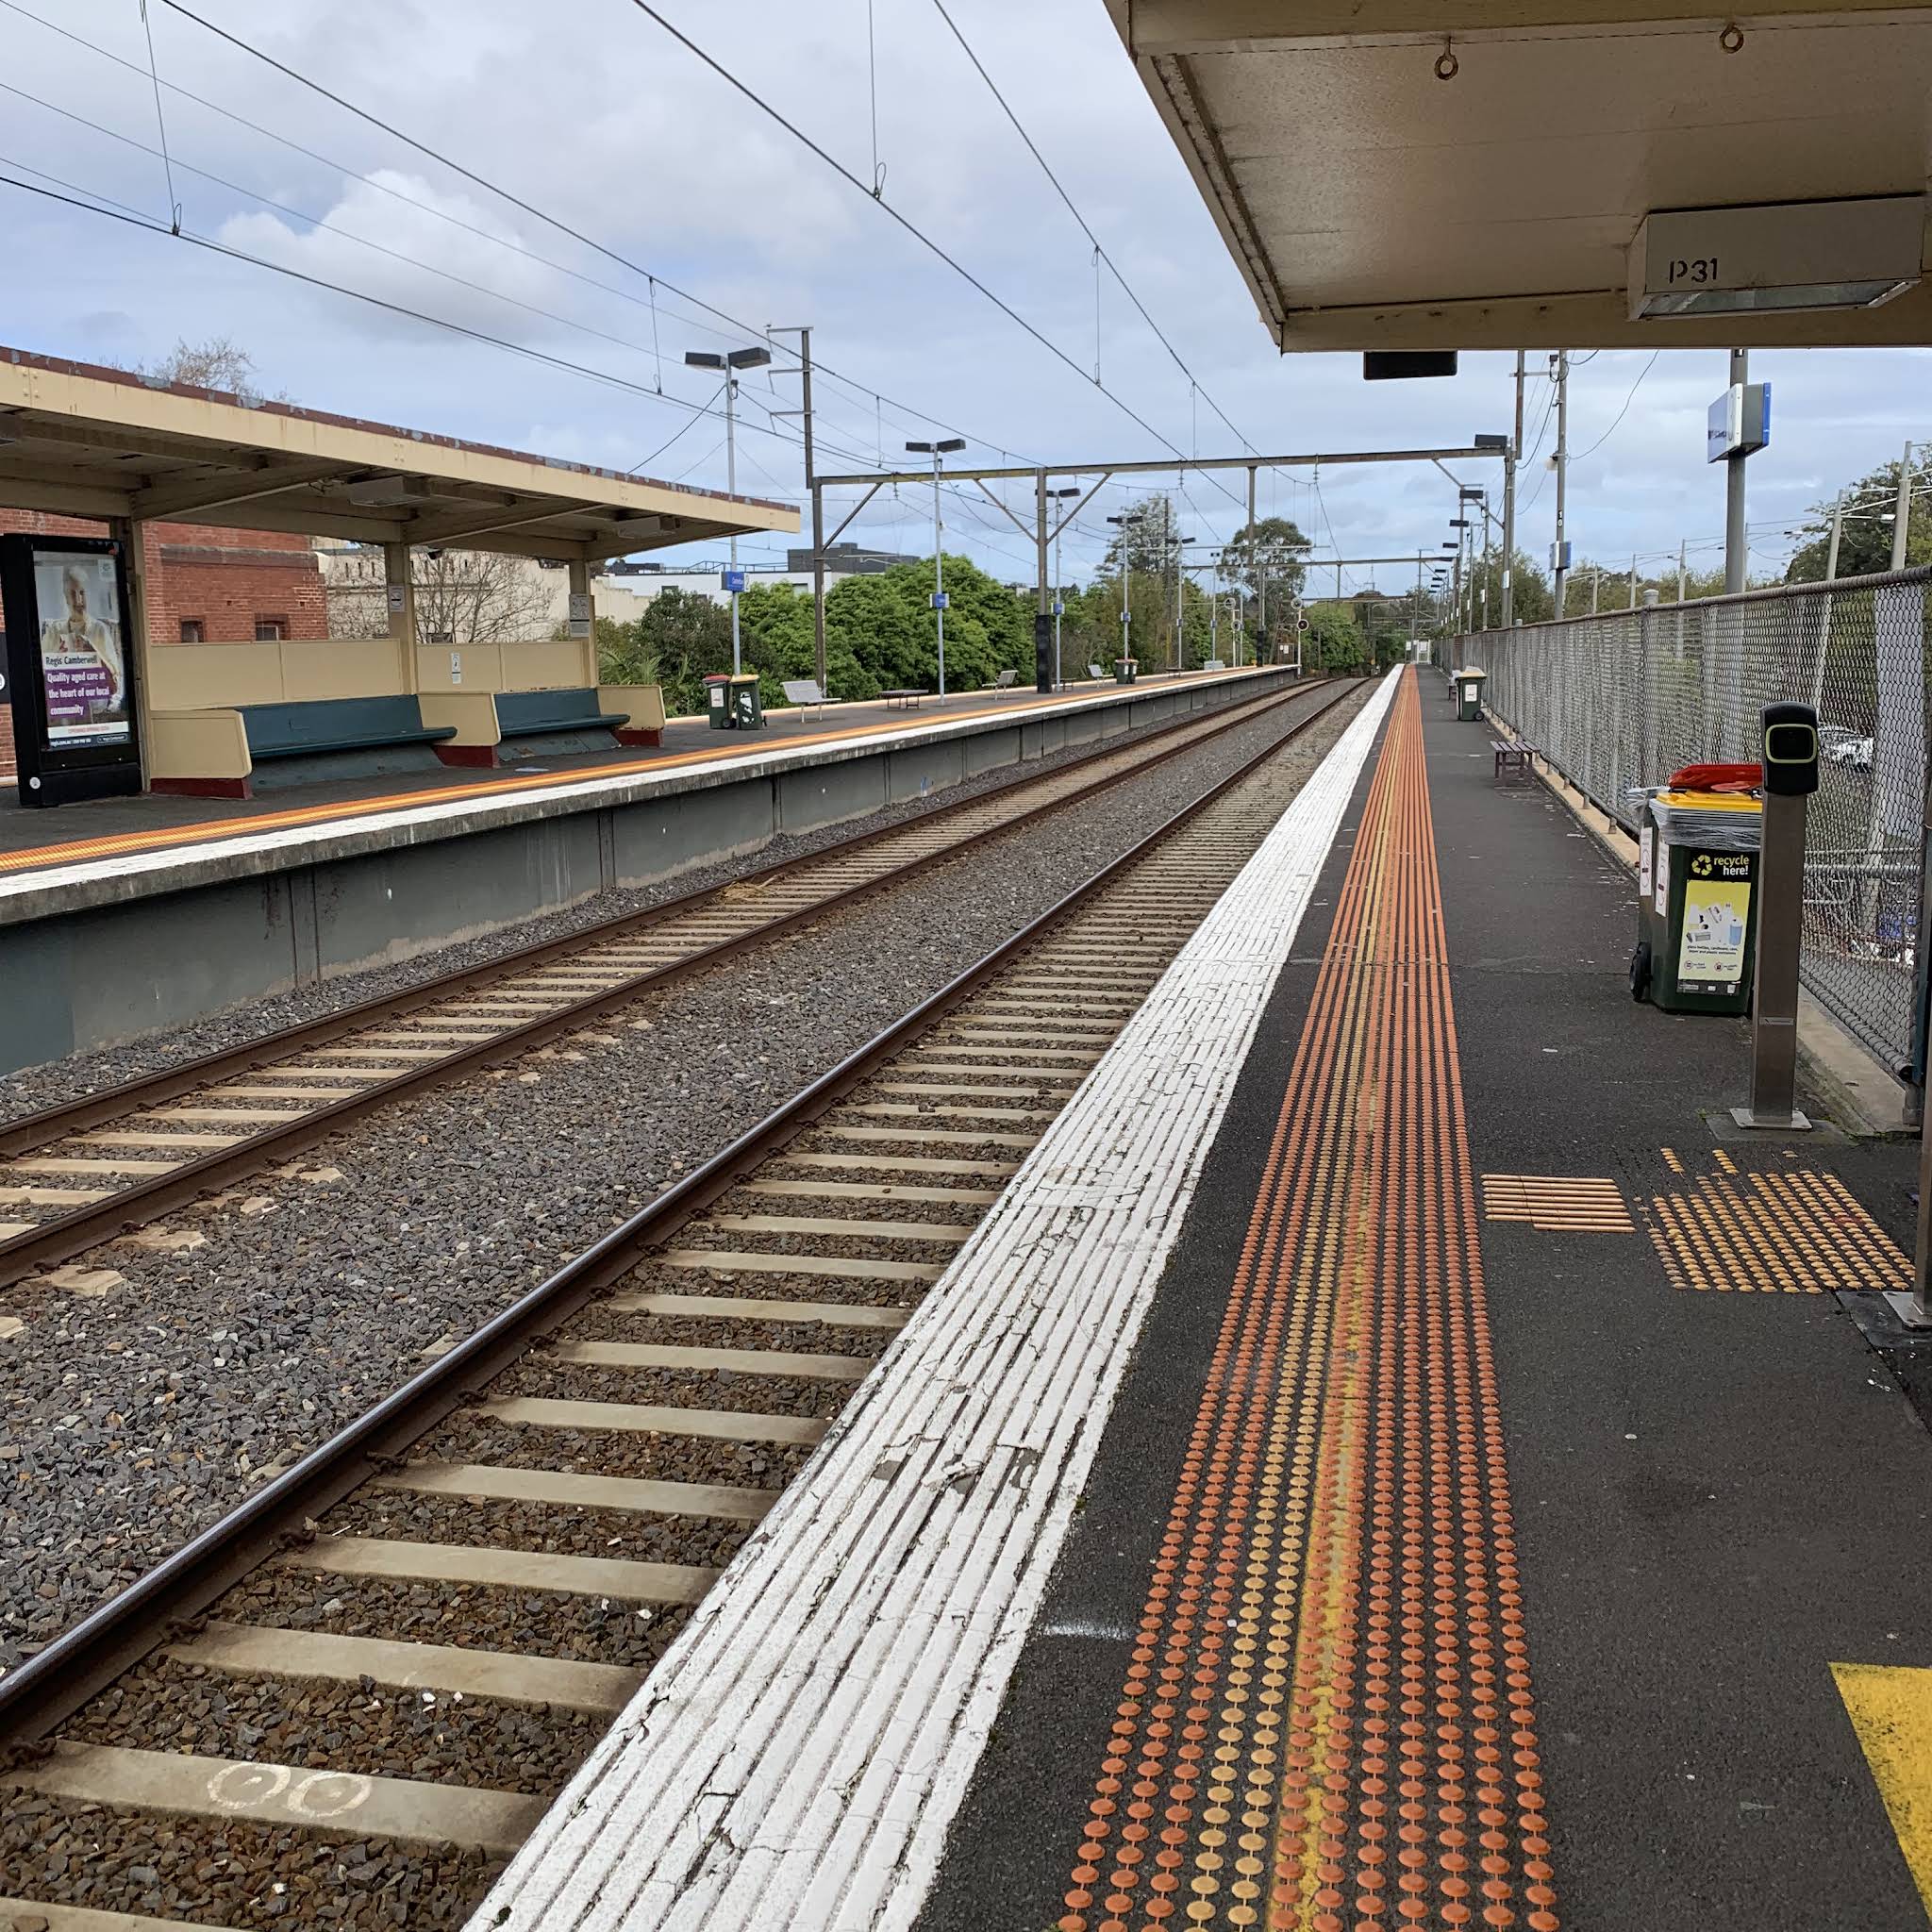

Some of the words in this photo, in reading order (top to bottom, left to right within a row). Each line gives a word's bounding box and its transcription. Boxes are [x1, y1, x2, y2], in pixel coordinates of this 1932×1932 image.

[1669, 258, 1717, 283] P31
[45, 657, 62, 667] Regis
[64, 655, 98, 664] Camberwell
[47, 672, 70, 683] Quality
[71, 672, 86, 683] aged
[48, 689, 59, 698] the
[59, 688, 76, 698] heart
[77, 687, 85, 697] of
[96, 687, 109, 696] local
[50, 704, 84, 715] community
[1713, 855, 1750, 868] recycle
[1723, 865, 1749, 875] here!
